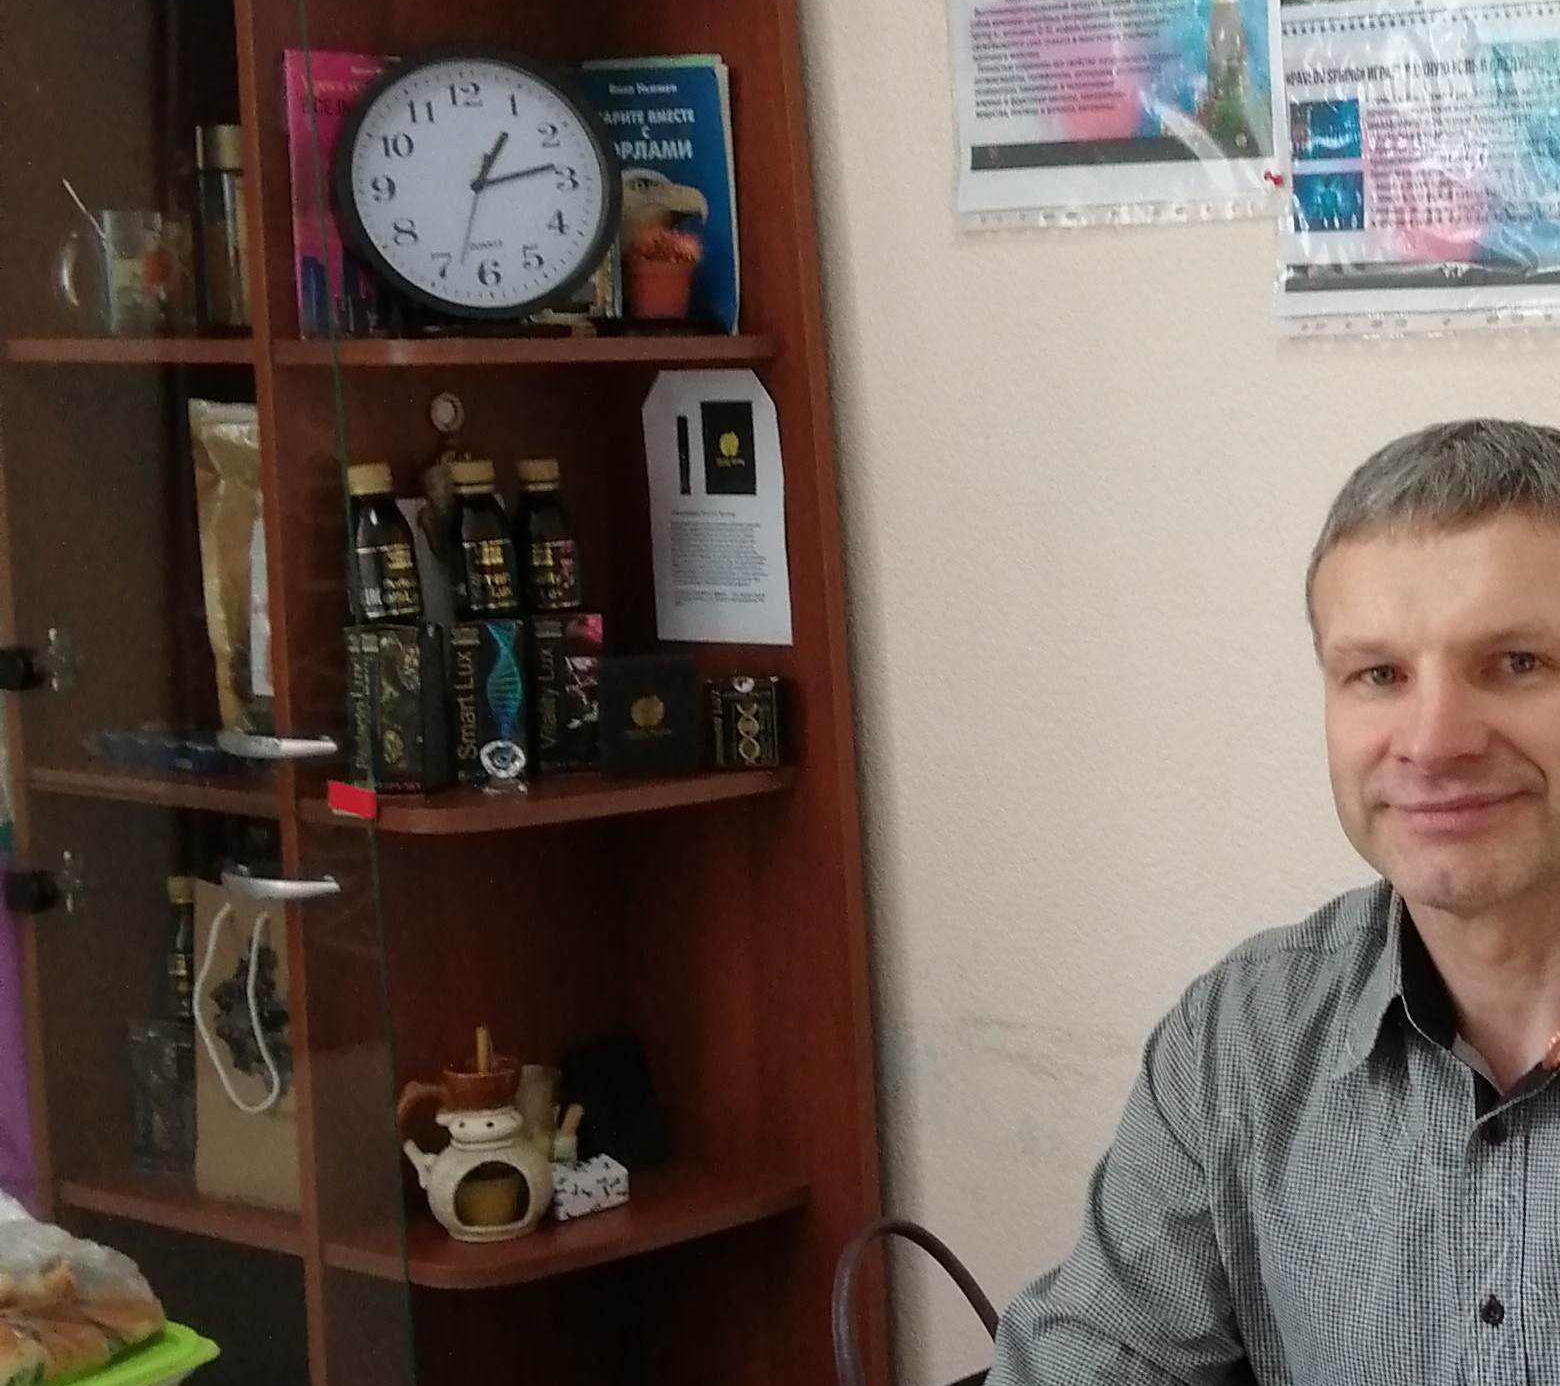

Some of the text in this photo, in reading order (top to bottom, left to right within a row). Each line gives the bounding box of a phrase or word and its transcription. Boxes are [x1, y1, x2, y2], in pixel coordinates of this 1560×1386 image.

[449, 82, 484, 108] 12
[508, 94, 519, 116] 1
[407, 100, 436, 124] 11
[600, 108, 695, 125] АРИТЕ ВМЕСТЕ
[382, 132, 414, 159] 10
[538, 124, 561, 148] 2
[371, 175, 396, 201] 9
[555, 166, 580, 192] 3
[393, 218, 419, 245] 8
[547, 210, 568, 235] 4
[430, 252, 451, 279] 7
[522, 245, 545, 272] 5
[478, 261, 501, 287] 6
[453, 651, 480, 760] Smart Lux
